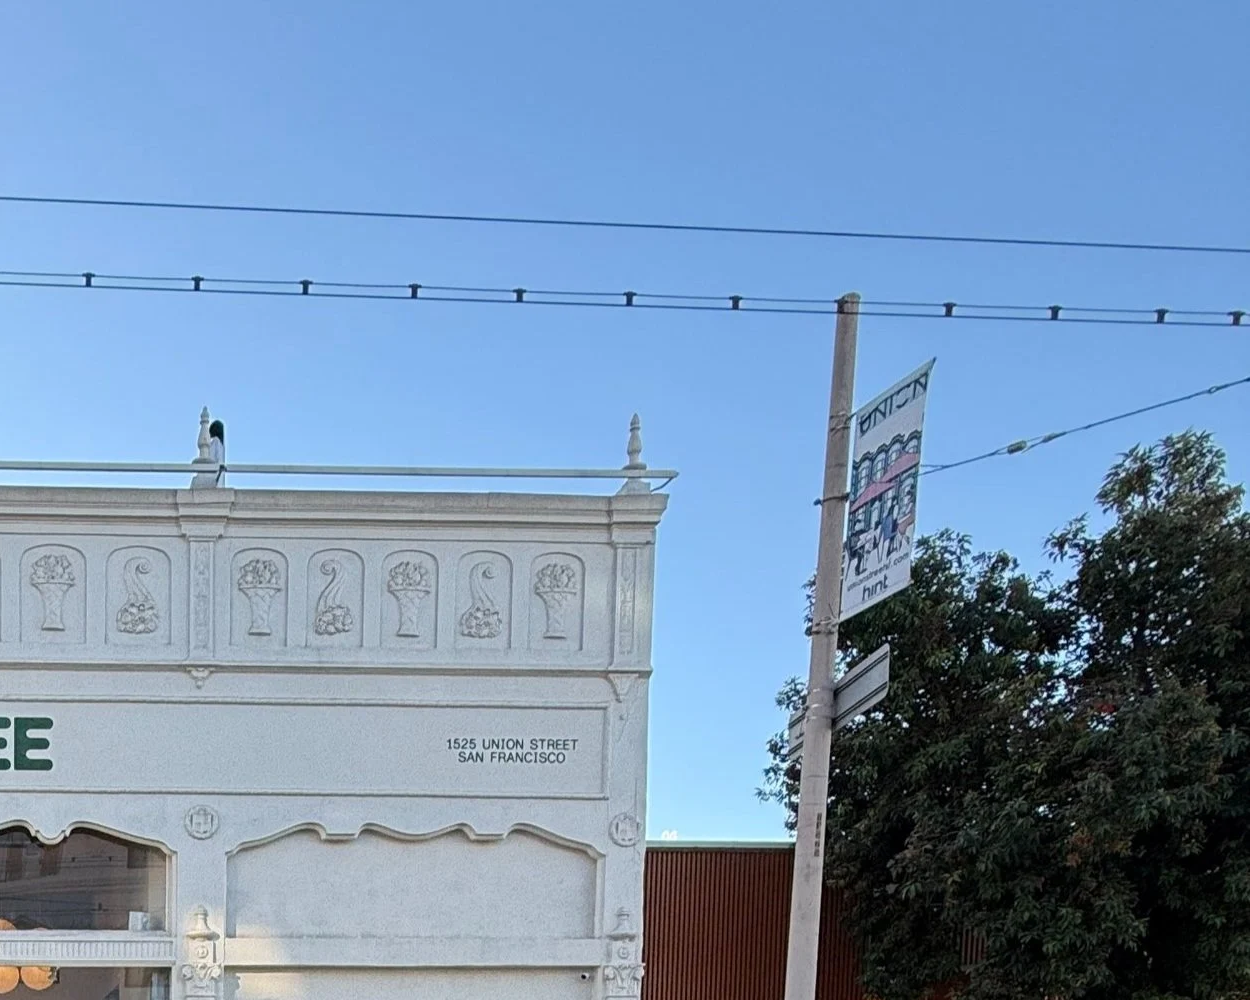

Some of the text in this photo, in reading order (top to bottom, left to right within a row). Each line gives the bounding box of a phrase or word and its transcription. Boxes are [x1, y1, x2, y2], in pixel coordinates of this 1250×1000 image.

[861, 573, 889, 602] hint
[446, 738, 579, 751] 1525 UNION STREET
[457, 751, 566, 764] SAN FRANCISCO
